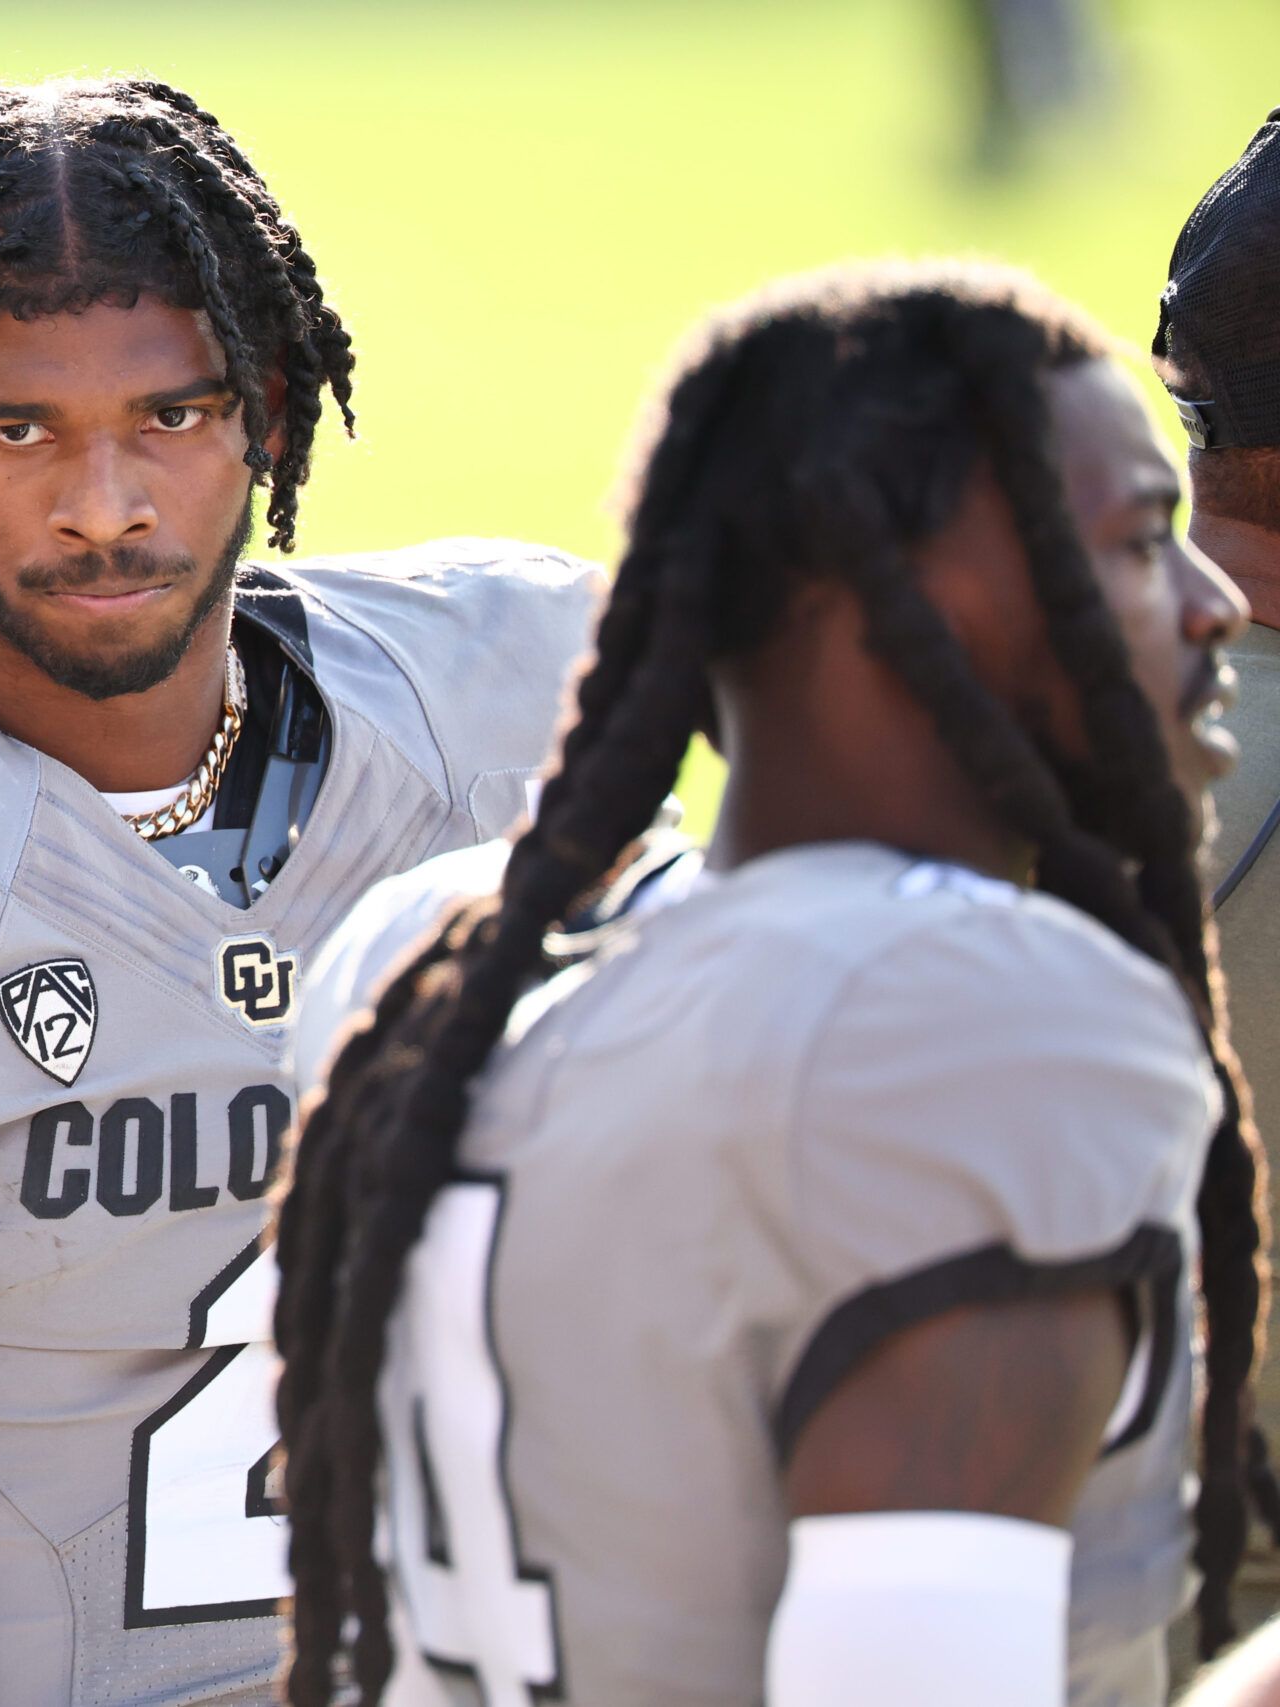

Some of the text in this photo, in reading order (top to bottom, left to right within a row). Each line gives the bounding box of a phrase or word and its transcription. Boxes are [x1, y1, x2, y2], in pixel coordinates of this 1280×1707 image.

[1, 964, 93, 1044] PAC
[222, 942, 293, 1021] CU
[33, 1012, 84, 1063] 12
